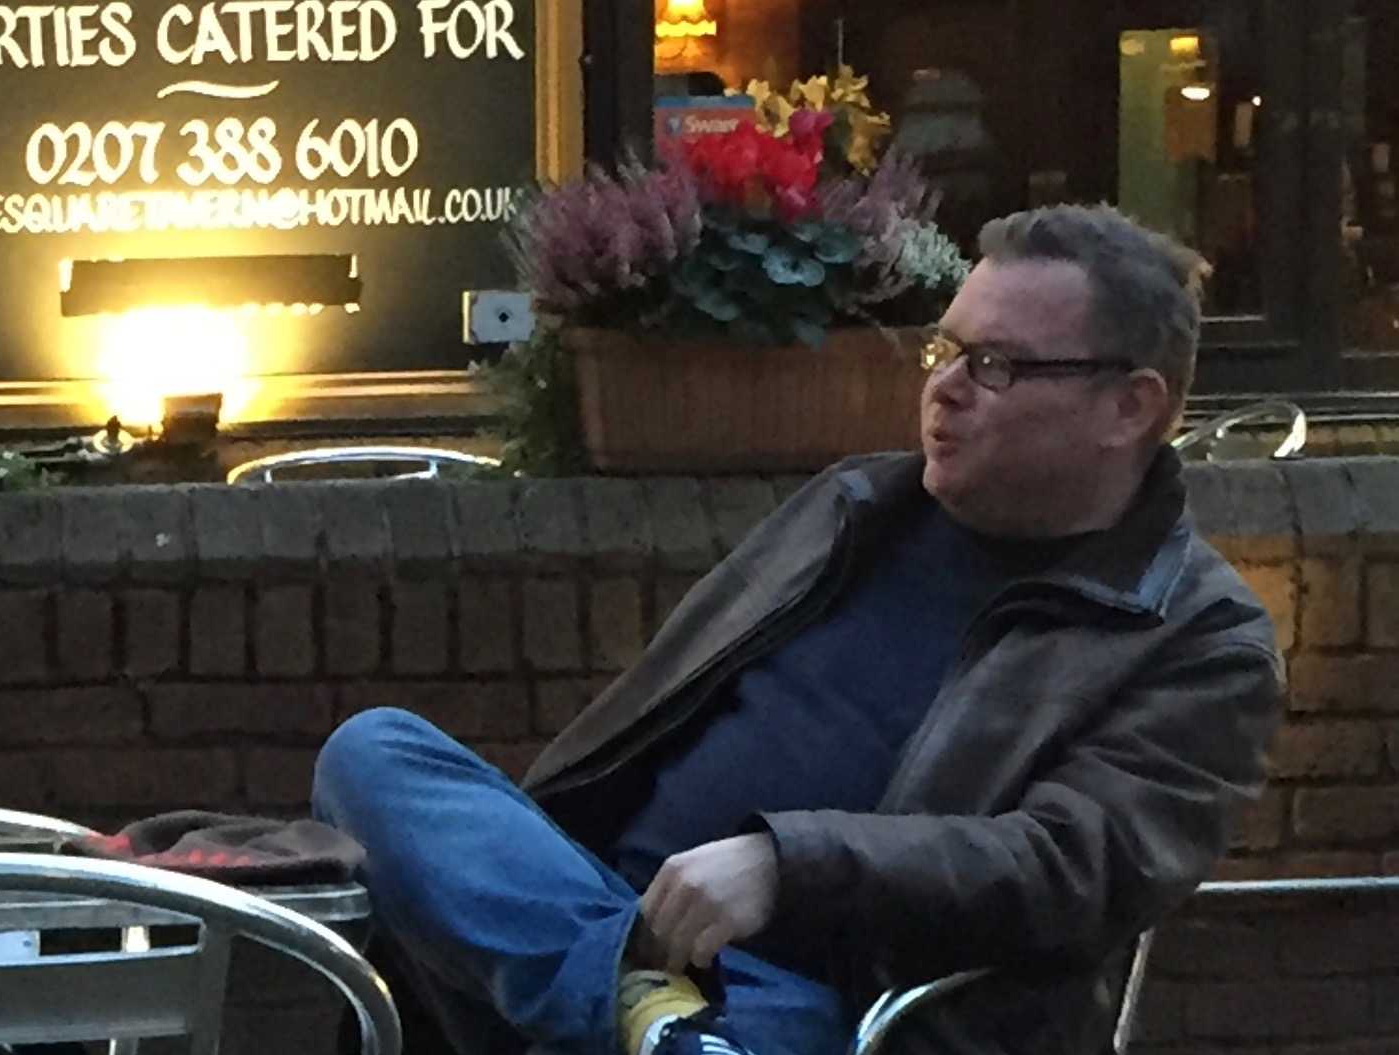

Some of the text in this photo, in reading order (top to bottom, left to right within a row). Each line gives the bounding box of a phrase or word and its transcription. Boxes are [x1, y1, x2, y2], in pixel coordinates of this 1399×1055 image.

[157, 0, 397, 65] CATERED
[416, 0, 526, 60] FOR
[25, 116, 419, 186] 0207 388 6010
